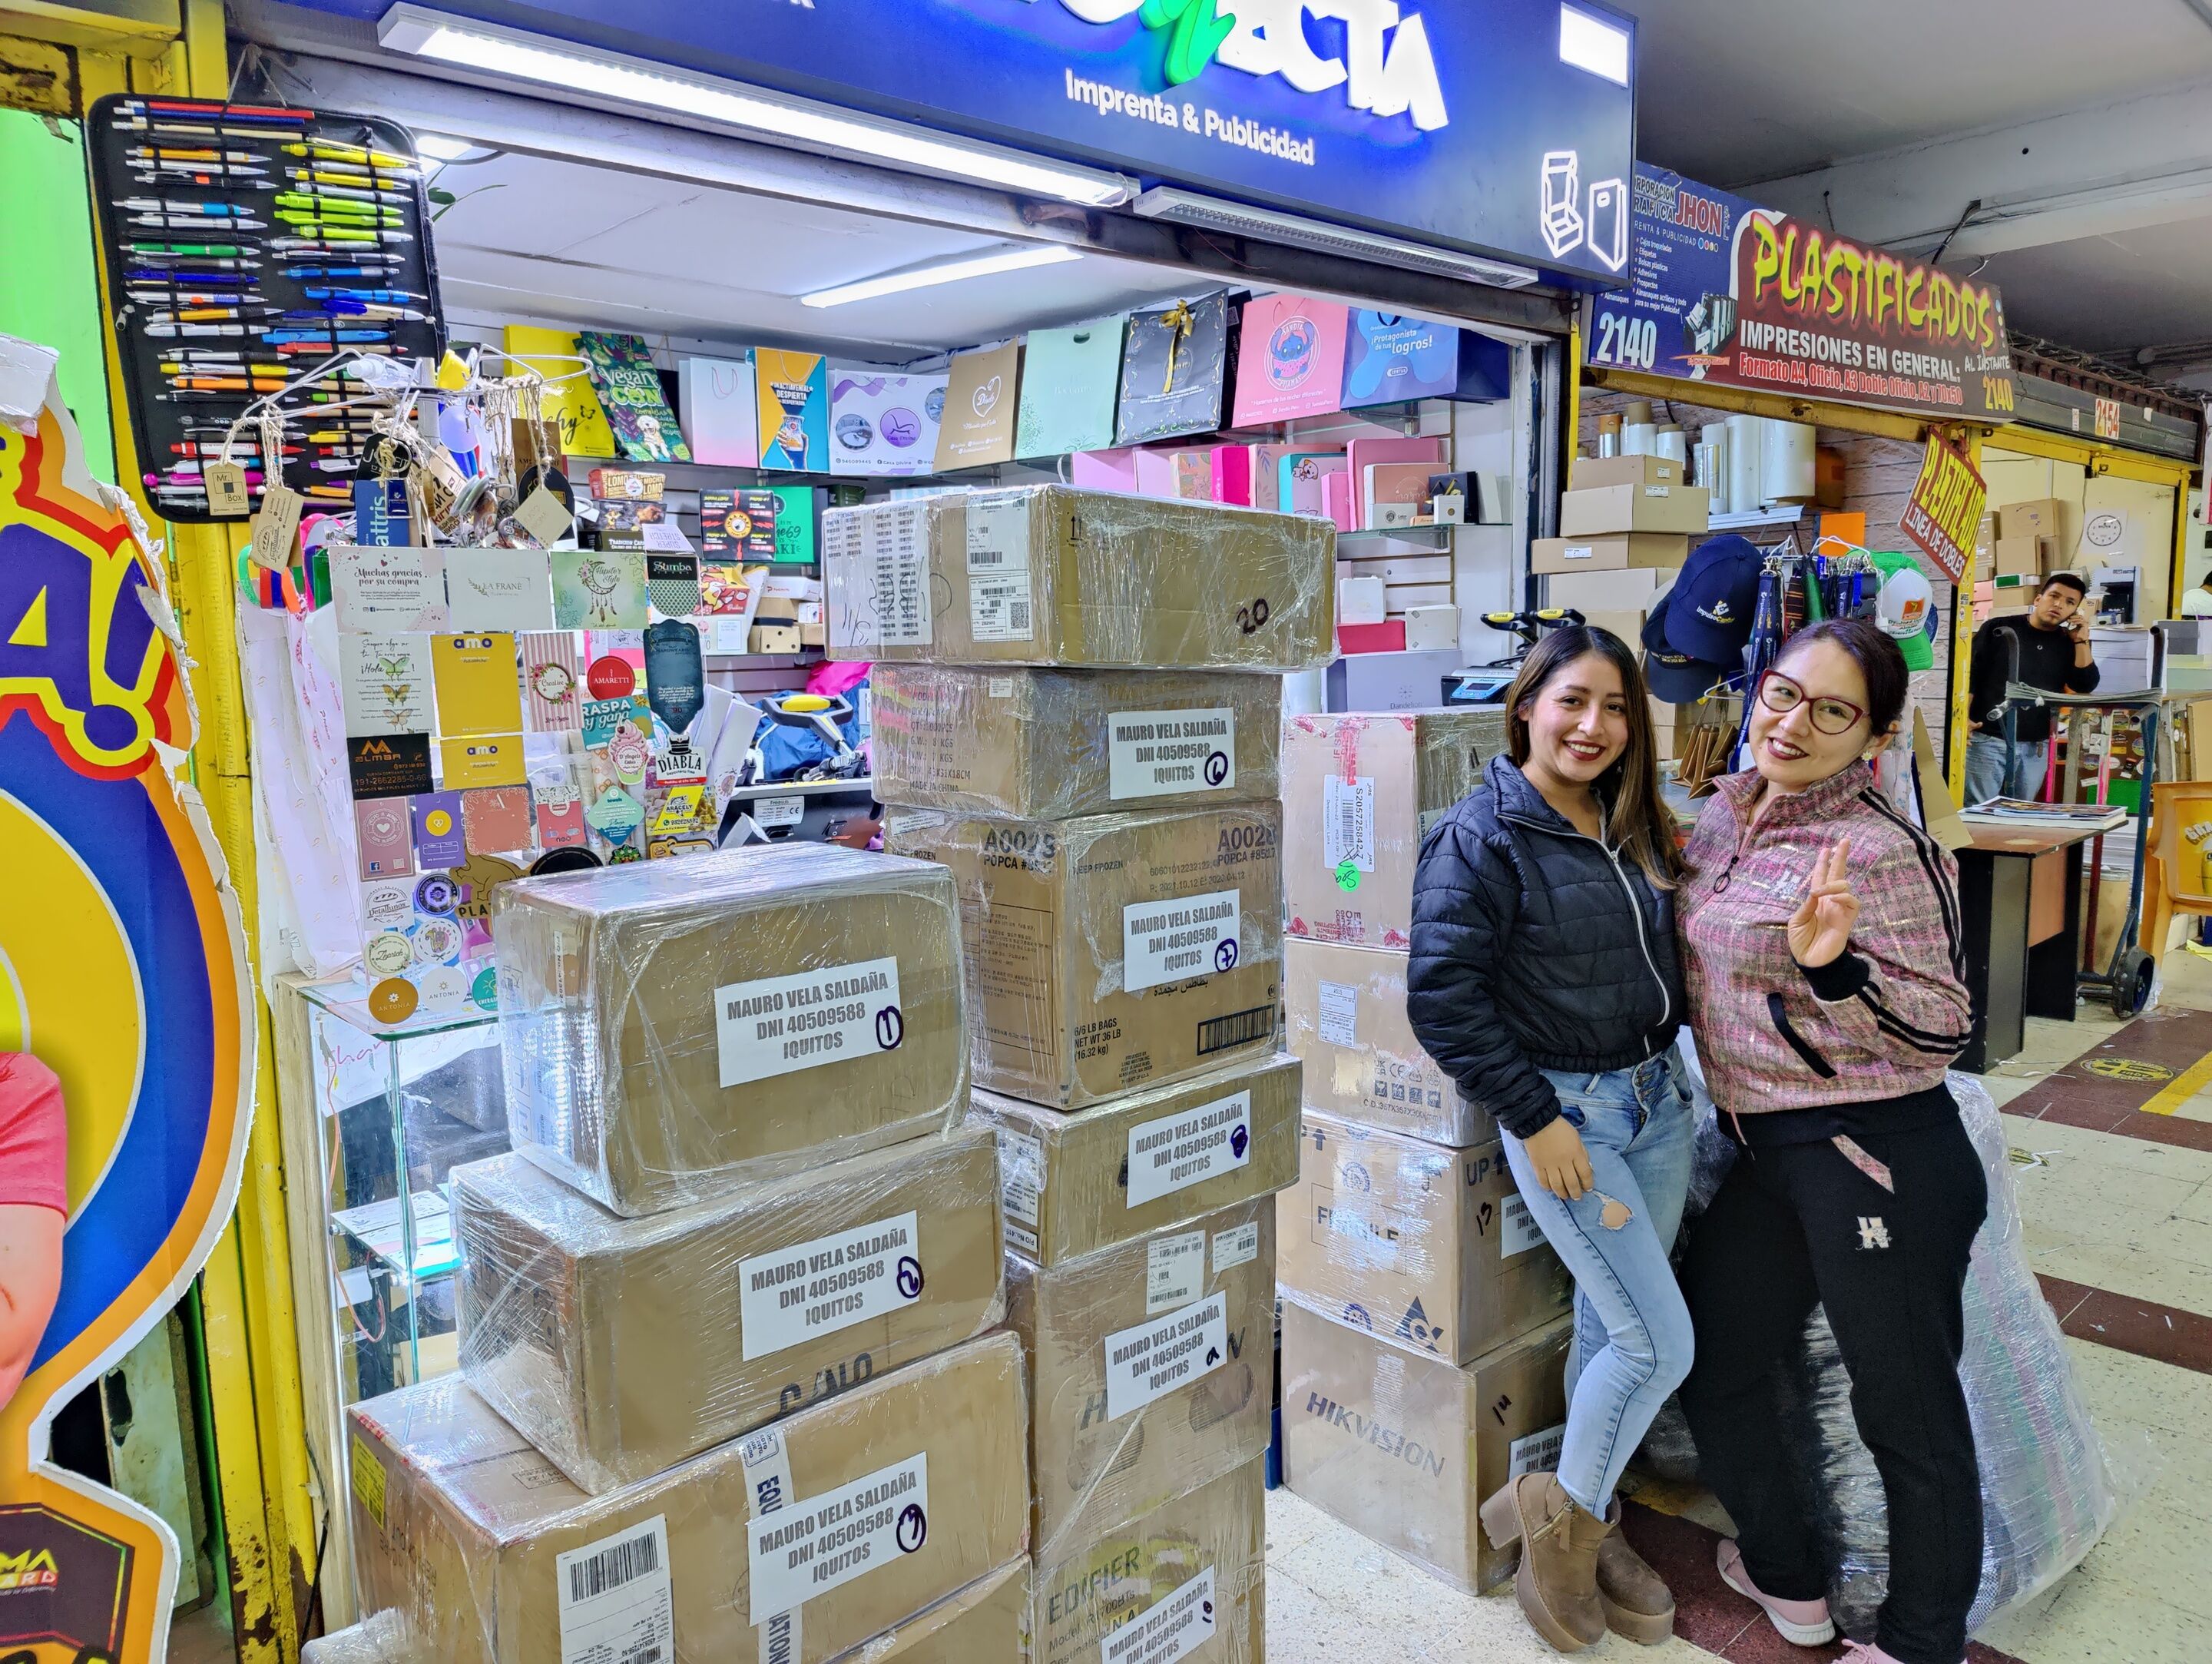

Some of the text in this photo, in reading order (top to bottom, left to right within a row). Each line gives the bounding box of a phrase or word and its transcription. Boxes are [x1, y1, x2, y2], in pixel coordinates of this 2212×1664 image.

[1065, 67, 1315, 167] Imprenta & Publicidad
[1674, 191, 1723, 237] JHON
[1662, 229, 1697, 247] PUBLICIDAD
[1752, 215, 1995, 349] PLASTIFICADOS
[1371, 329, 1417, 345] ¡Protagonista
[1392, 336, 1432, 355] logros!
[1597, 311, 1657, 370] 2140
[1740, 319, 1961, 383] IMPRESIONES EN GENERAL:
[1965, 356, 1975, 373] AL
[598, 366, 657, 389] Vegan
[1739, 352, 1788, 382] Formato
[1790, 361, 1808, 387] A4,
[1809, 363, 1843, 392] Oficio,
[1844, 371, 1857, 393] A3
[1859, 374, 1887, 396] Doble
[1889, 375, 1918, 401] Oficio,
[1919, 382, 1929, 403] A2
[1936, 383, 1963, 406] 70x50
[777, 391, 807, 400] DESPIERTA
[1983, 376, 2014, 412] 2140
[2095, 400, 2120, 439] 2154
[644, 482, 663, 495] LOMO
[1905, 503, 1965, 578] LINEA DE DOBLES
[354, 567, 422, 579] Muchas gracias
[653, 560, 692, 573] Sumba
[359, 578, 374, 587] por
[386, 578, 419, 587] compra
[1235, 598, 1269, 636] 20
[453, 638, 492, 649] amo
[582, 699, 631, 717] RASPA
[598, 711, 630, 728] gana
[940, 738, 953, 747] KGS
[1116, 719, 1227, 743] MAURO VELA SALDAÑA
[467, 745, 498, 757] amo
[658, 754, 701, 773] DIABLA
[940, 754, 953, 763] KGS
[1136, 742, 1211, 763] DNI 40509588
[1154, 765, 1195, 784] IQUITOS
[938, 784, 959, 793] CHINA
[666, 804, 694, 812] ARACELY
[910, 848, 1018, 870] FROZEN POPCA
[1094, 860, 1124, 873] FROZEN
[1217, 851, 1248, 867] POPCA
[1131, 902, 1233, 936] MAURO VELA SALDAÑA
[1149, 926, 1218, 954] DNI 40509588
[1164, 950, 1202, 972] IQUITOS
[378, 1002, 411, 1012] ANTONIA
[429, 990, 460, 999] ANTONIA
[727, 971, 889, 1020] MAURO VELA SALDAÑA
[757, 1002, 866, 1040] DNI 40509588
[1075, 1018, 1118, 1036] 6/6 LB BAGS
[783, 1031, 843, 1059] IQUITOS
[1075, 1029, 1121, 1048] NET WT 36 LB
[1075, 1046, 1108, 1062] (16.32 kg)
[1135, 1102, 1243, 1155] MAURO VELA SALDAÑA
[1154, 1130, 1227, 1168] DNI 40509588
[1170, 1155, 1211, 1182] IQUITOS
[1465, 1159, 1490, 1186] UP
[1506, 1201, 1528, 1218] MAUR
[1517, 1216, 1528, 1229] DNI
[751, 1228, 908, 1292] MAURO VELA SALDAÑA
[780, 1260, 885, 1309] DNI 40509588
[806, 1291, 864, 1326] IQUITOS
[1113, 1304, 1220, 1366] MAURO VELA SALDAÑA
[1132, 1332, 1204, 1378] DNI 40509588
[1149, 1359, 1190, 1391] IQUITOS
[1306, 1391, 1445, 1478] HIKVISION
[1515, 1436, 1558, 1463] MAURO VELA
[1526, 1458, 1539, 1473] DNI
[757, 1475, 783, 1516] EQU
[759, 1470, 917, 1555] MAURO VELA SALDAÑA
[788, 1507, 894, 1570] DNI 40509588
[813, 1541, 871, 1583] IQUITOS
[1048, 1546, 1141, 1625] EDIFIER
[1109, 1631, 1144, 1660] MAURO
[1145, 1616, 1168, 1639] VELA
[1170, 1580, 1209, 1618] SALDAÑA
[1048, 1625, 1081, 1652] Model
[1126, 1647, 1143, 1664] DNI
[1144, 1610, 1194, 1653] 40509588
